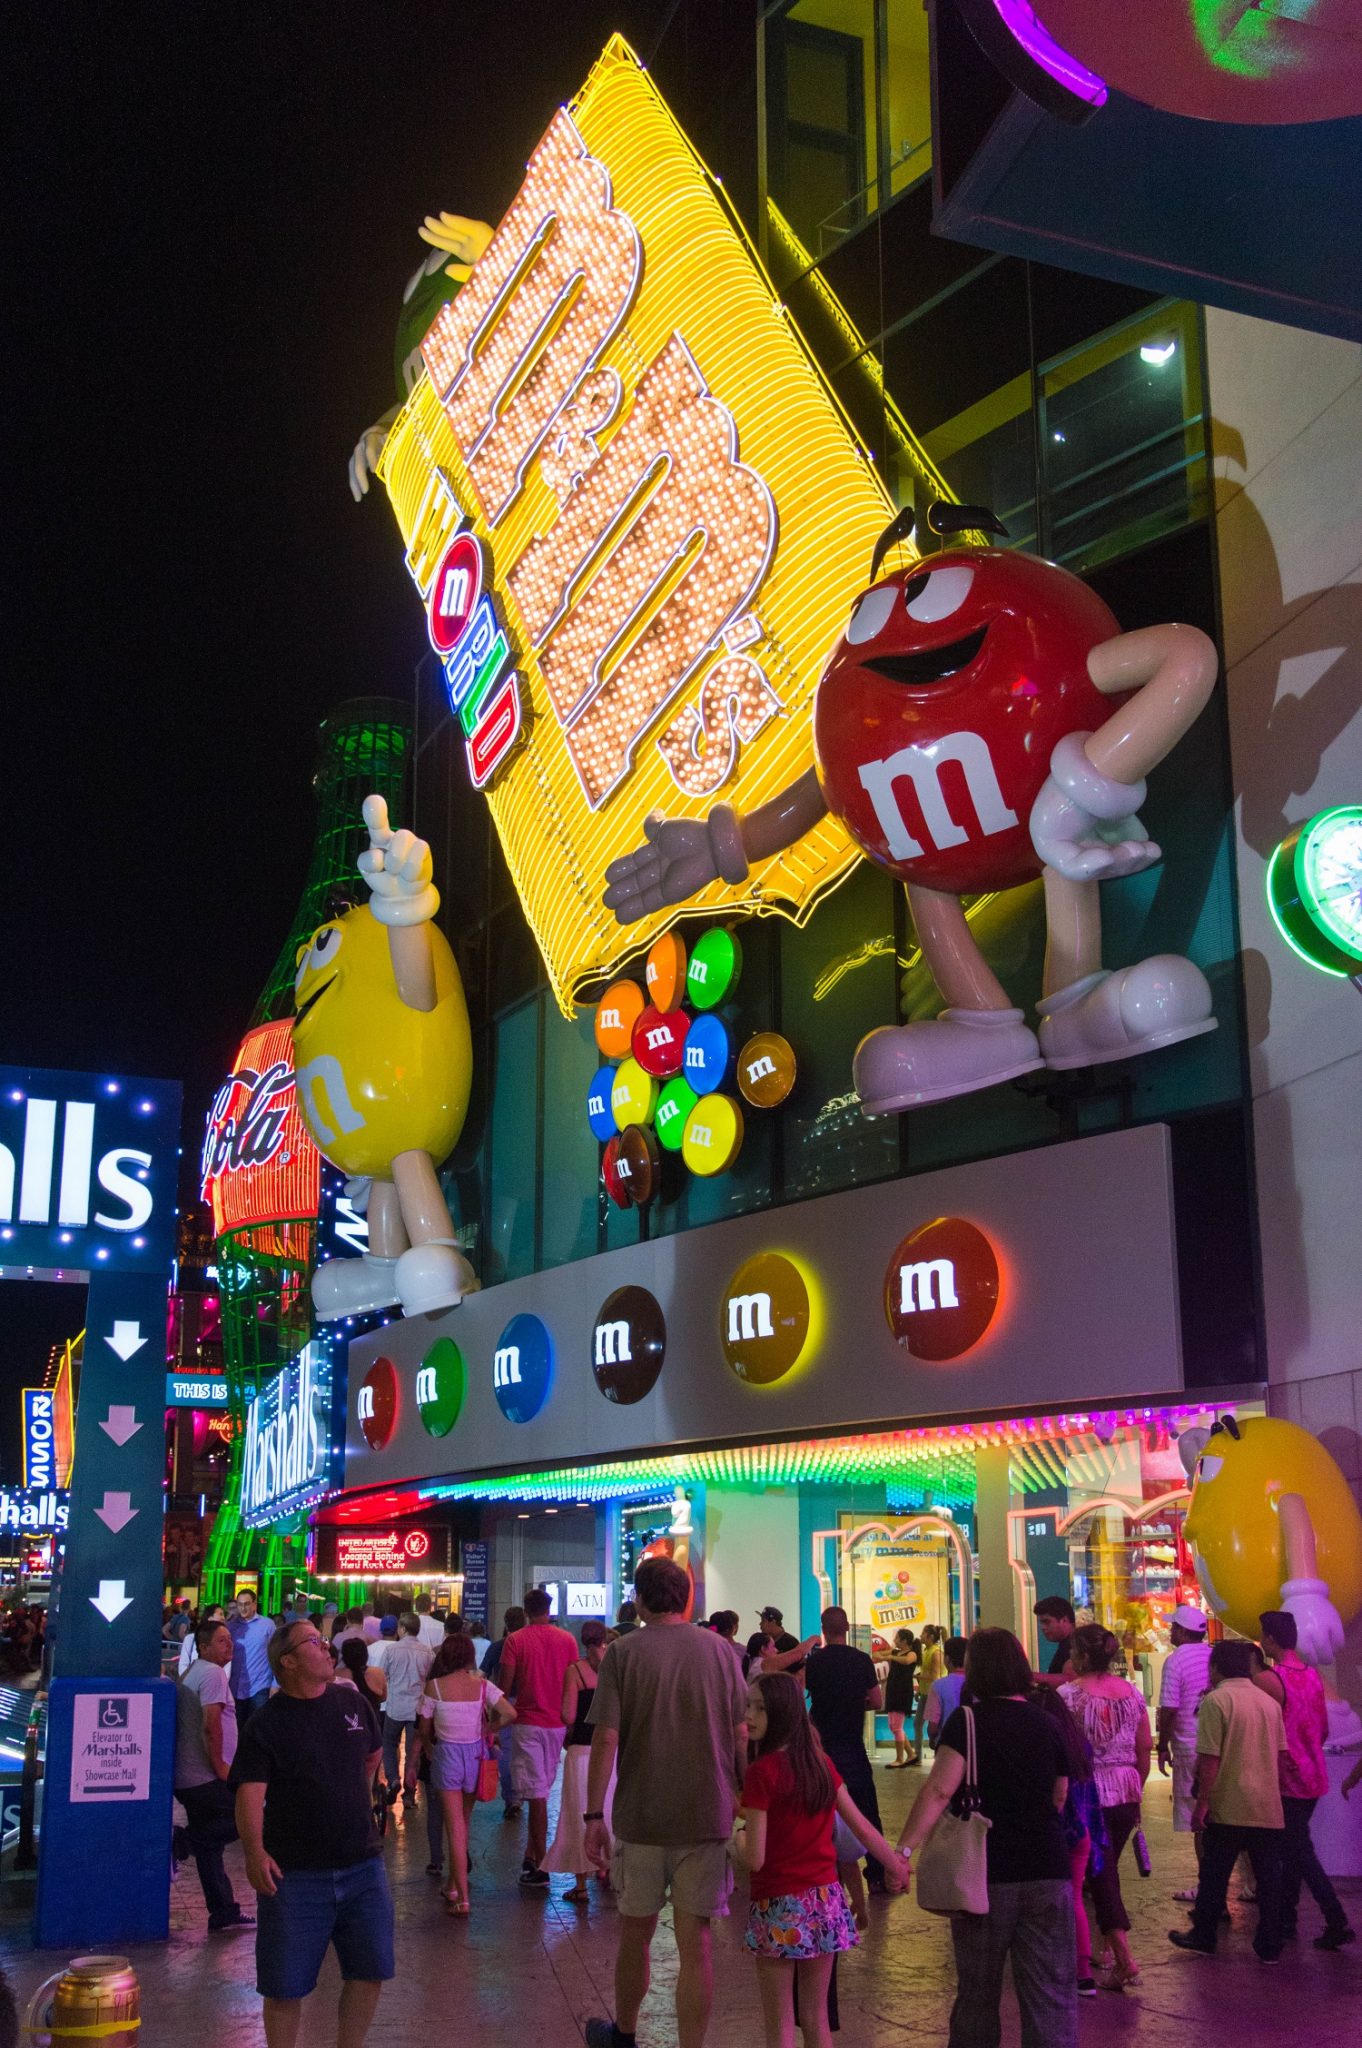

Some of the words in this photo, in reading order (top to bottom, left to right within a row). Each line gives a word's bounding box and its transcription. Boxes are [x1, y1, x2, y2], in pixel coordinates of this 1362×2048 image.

[857, 730, 1021, 861] m
[688, 958, 708, 984] m
[600, 1008, 621, 1029] m
[645, 1025, 674, 1050] m
[686, 1046, 706, 1068] m
[746, 1055, 777, 1085] m
[588, 1095, 606, 1116] m
[657, 1099, 680, 1127] m
[689, 1123, 712, 1147] m
[899, 1256, 959, 1314] m
[727, 1289, 775, 1342] m
[595, 1320, 632, 1366] m
[493, 1345, 522, 1388] m
[173, 1383, 210, 1398] THIS
[212, 1384, 228, 1399] IS
[416, 1367, 438, 1405] m
[357, 1385, 375, 1420] m
[240, 1338, 318, 1516] Marshalls
[339, 1552, 372, 1561] Located
[375, 1552, 405, 1561] Behind
[341, 1560, 360, 1569] Hard
[363, 1560, 384, 1569] Rock
[386, 1560, 405, 1569] Cafe
[572, 1594, 603, 1608] ATM
[92, 1731, 122, 1742] Elevator
[125, 1733, 133, 1742] to
[81, 1743, 142, 1756] Marshalls
[85, 1769, 119, 1780] Showcase
[122, 1768, 137, 1779] Mall
[100, 1758, 122, 1767] inside
